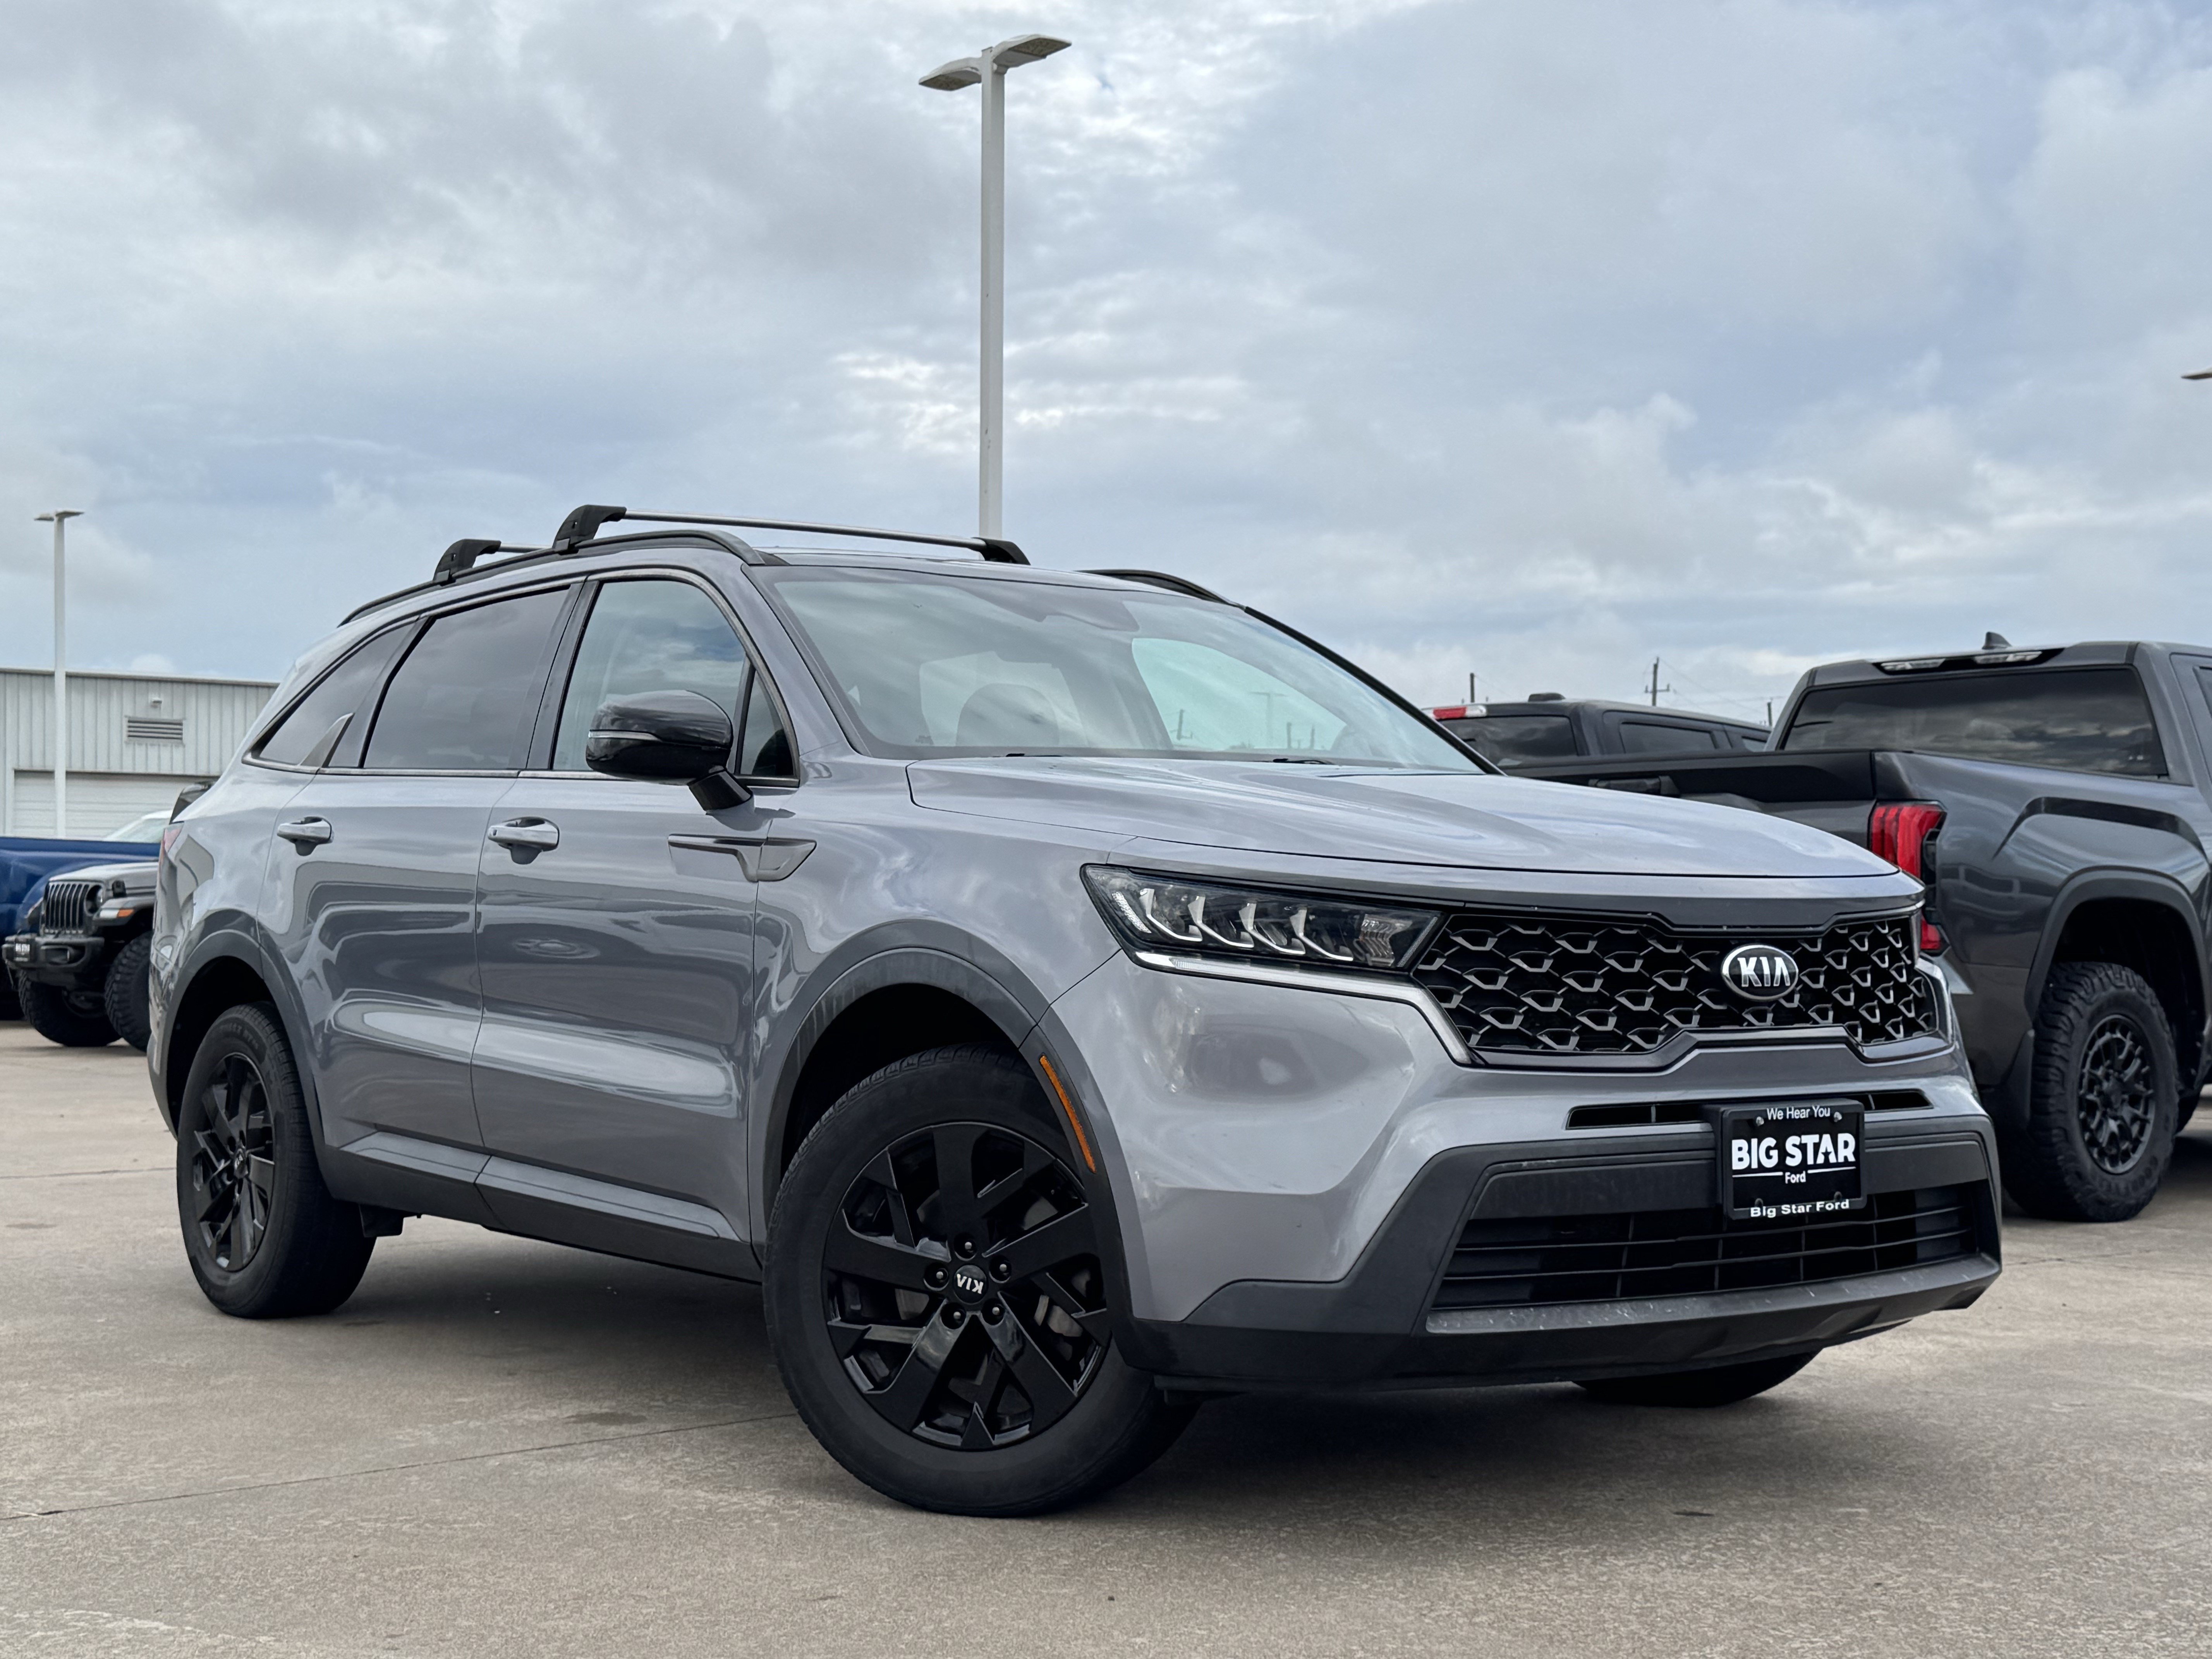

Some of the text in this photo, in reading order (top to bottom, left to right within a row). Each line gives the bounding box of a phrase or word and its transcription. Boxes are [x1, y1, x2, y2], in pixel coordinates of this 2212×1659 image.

[1737, 957, 1790, 987] KIA
[1767, 1105, 1831, 1120] We Hear You
[1732, 1133, 1856, 1170] BIG STAR
[1785, 1171, 1806, 1184] Ford
[1781, 1203, 1811, 1214] Star
[1816, 1199, 1850, 1211] Ford
[957, 1273, 984, 1294] KIA
